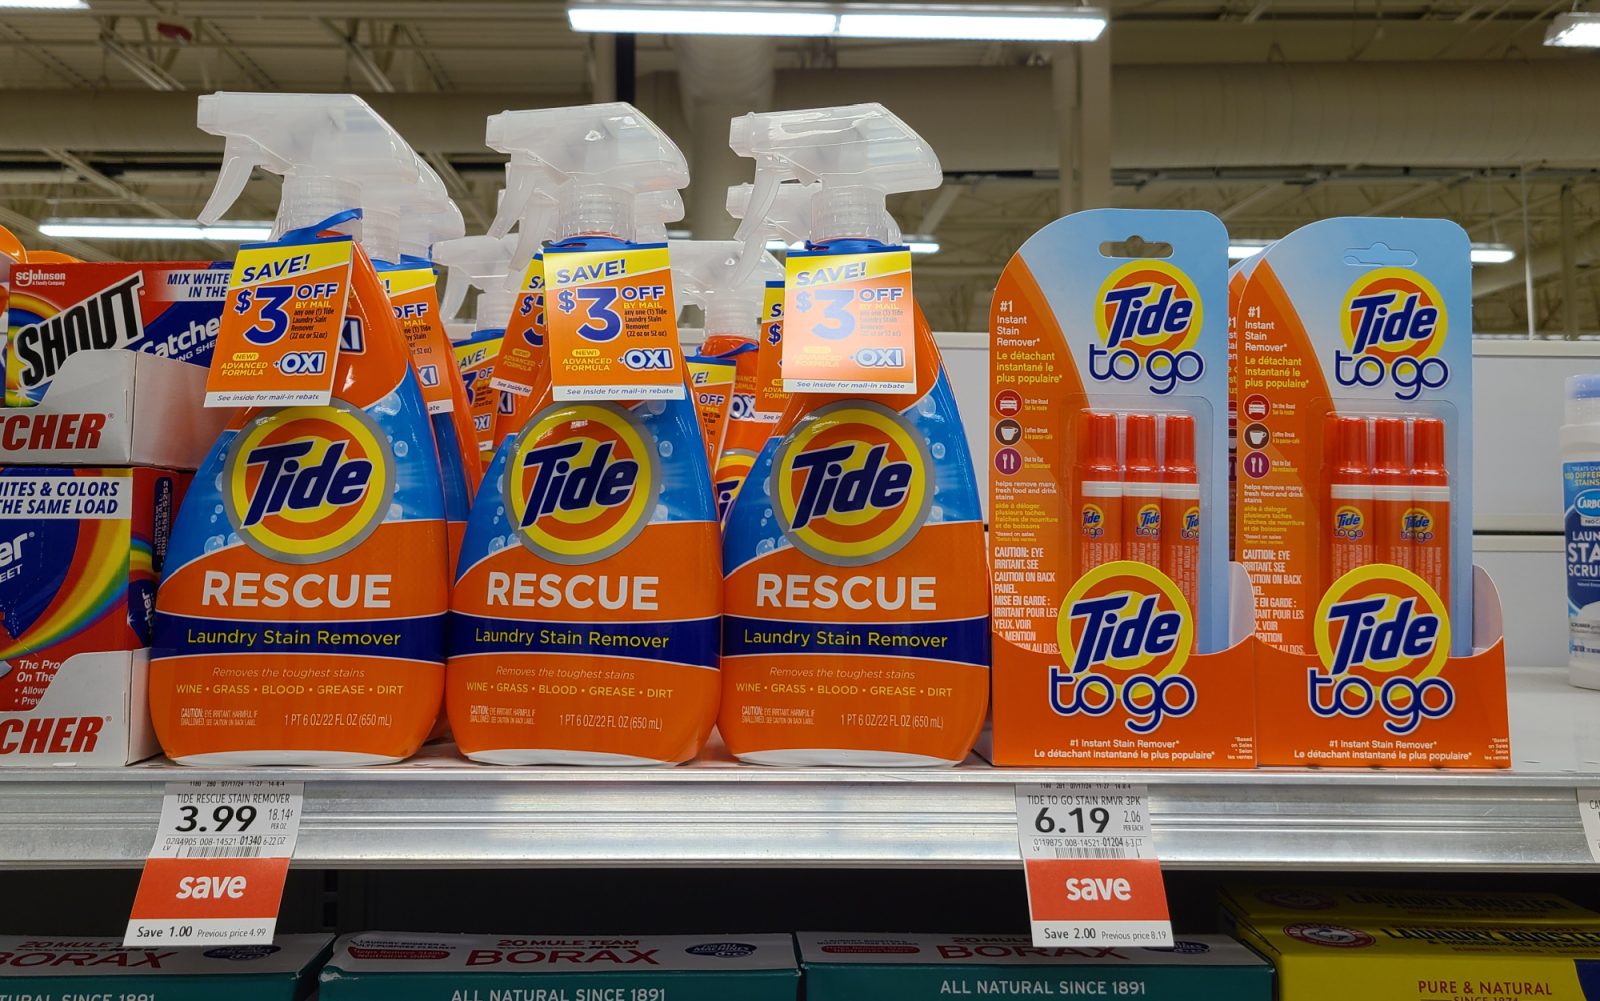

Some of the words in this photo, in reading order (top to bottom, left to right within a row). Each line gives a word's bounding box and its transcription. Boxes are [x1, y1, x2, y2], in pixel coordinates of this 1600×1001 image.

[241, 254, 310, 282] SAVE!
[556, 259, 626, 283] SAVE!
[796, 262, 866, 286] SAVE!
[168, 274, 189, 284] MIX
[193, 273, 232, 284] WHITE
[188, 287, 204, 297] IN
[206, 287, 226, 297] THE
[297, 283, 338, 299] OFF
[621, 286, 665, 300] OFF
[859, 288, 902, 302] OFF
[1000, 301, 1012, 312] #1
[997, 316, 1027, 324] Instant
[1104, 285, 1194, 348] Tide
[1349, 292, 1439, 354] Tide
[15, 272, 144, 386] SHOUT
[138, 315, 223, 356] Catche
[997, 327, 1019, 335] Stain
[997, 352, 1008, 360] Le
[1010, 351, 1055, 360] détachant
[997, 363, 1043, 371] instantané
[1046, 363, 1053, 371] le
[1089, 344, 1140, 381] to
[1146, 350, 1203, 394] go
[1335, 350, 1384, 387] to
[1391, 356, 1448, 400] go
[997, 375, 1015, 384] plus
[40, 482, 52, 496] &
[57, 482, 120, 496] COLORS
[241, 440, 373, 529] Tide
[518, 440, 639, 530] Tide
[788, 443, 912, 532] Tide
[27, 499, 72, 514] SAME
[75, 499, 118, 514] LOAD
[995, 547, 1029, 557] CAUTION:
[1031, 548, 1044, 557] EYE
[1027, 560, 1039, 569] SEE
[995, 572, 1024, 581] CAUTION
[1026, 572, 1035, 581] ON
[1037, 572, 1055, 582] BACK
[202, 570, 392, 608] RESCUE
[486, 571, 659, 610] RESCUE
[756, 573, 937, 610] RESCUE
[188, 629, 257, 646] Laundry
[264, 630, 311, 644] Stain
[318, 630, 401, 645] Remover
[476, 628, 534, 646] Laundry
[540, 630, 582, 645] Stain
[589, 631, 669, 648] Remover
[744, 629, 810, 647] Laundry
[816, 630, 861, 645] Stain
[868, 632, 948, 648] Remover
[1069, 594, 1181, 674] Tide
[1327, 597, 1440, 675] Tide
[213, 667, 258, 677] Removes
[261, 667, 279, 677] the
[282, 668, 330, 680] toughest
[334, 668, 365, 677] stains
[176, 685, 202, 694] WINE
[213, 685, 250, 694] GRASS
[262, 685, 304, 694] BLOOD
[317, 685, 364, 695] GREASE
[377, 685, 404, 694] DIRT
[1049, 666, 1115, 715] to
[1122, 674, 1197, 734] go
[1308, 667, 1374, 718] to
[1381, 676, 1455, 735] go
[847, 714, 857, 725] PT
[859, 715, 864, 725] 6
[866, 714, 888, 727] OZ/22
[890, 715, 898, 727] FL
[901, 715, 911, 727] OZ
[912, 715, 928, 728] (650
[930, 717, 943, 729] mL)
[177, 794, 194, 803] TIDE
[196, 794, 226, 803] RESCUE
[228, 794, 250, 803] STAIN
[253, 794, 290, 803] REMOVER
[1027, 795, 1044, 805] TIDE
[1047, 795, 1057, 805] TO
[1061, 795, 1073, 805] GO
[1076, 796, 1098, 805] STAIN
[1101, 796, 1123, 805] RMVR
[1126, 796, 1141, 805] 3PK
[175, 805, 257, 832] 3.99
[1035, 807, 1110, 833] 6.19
[1124, 810, 1140, 822] 2.06
[176, 876, 246, 898] save
[1066, 878, 1131, 901] save
[137, 926, 163, 937] Save
[169, 926, 192, 936] 1.00
[197, 929, 227, 937] Previous
[229, 929, 248, 939] price
[249, 928, 266, 936] 4.99
[1044, 928, 1068, 939] Save
[1074, 928, 1096, 938] 2.00
[1102, 931, 1130, 940] Previous
[1133, 932, 1150, 942] price
[1151, 931, 1166, 939] 8.19
[466, 950, 660, 966] BORAX
[940, 981, 971, 994] ALL
[977, 981, 1053, 994] NATURAL
[1059, 982, 1107, 994] SINCE
[1112, 982, 1145, 995] 1891
[1418, 981, 1457, 994] PURE
[1463, 982, 1474, 994] &
[1480, 982, 1552, 996] NATURAL
